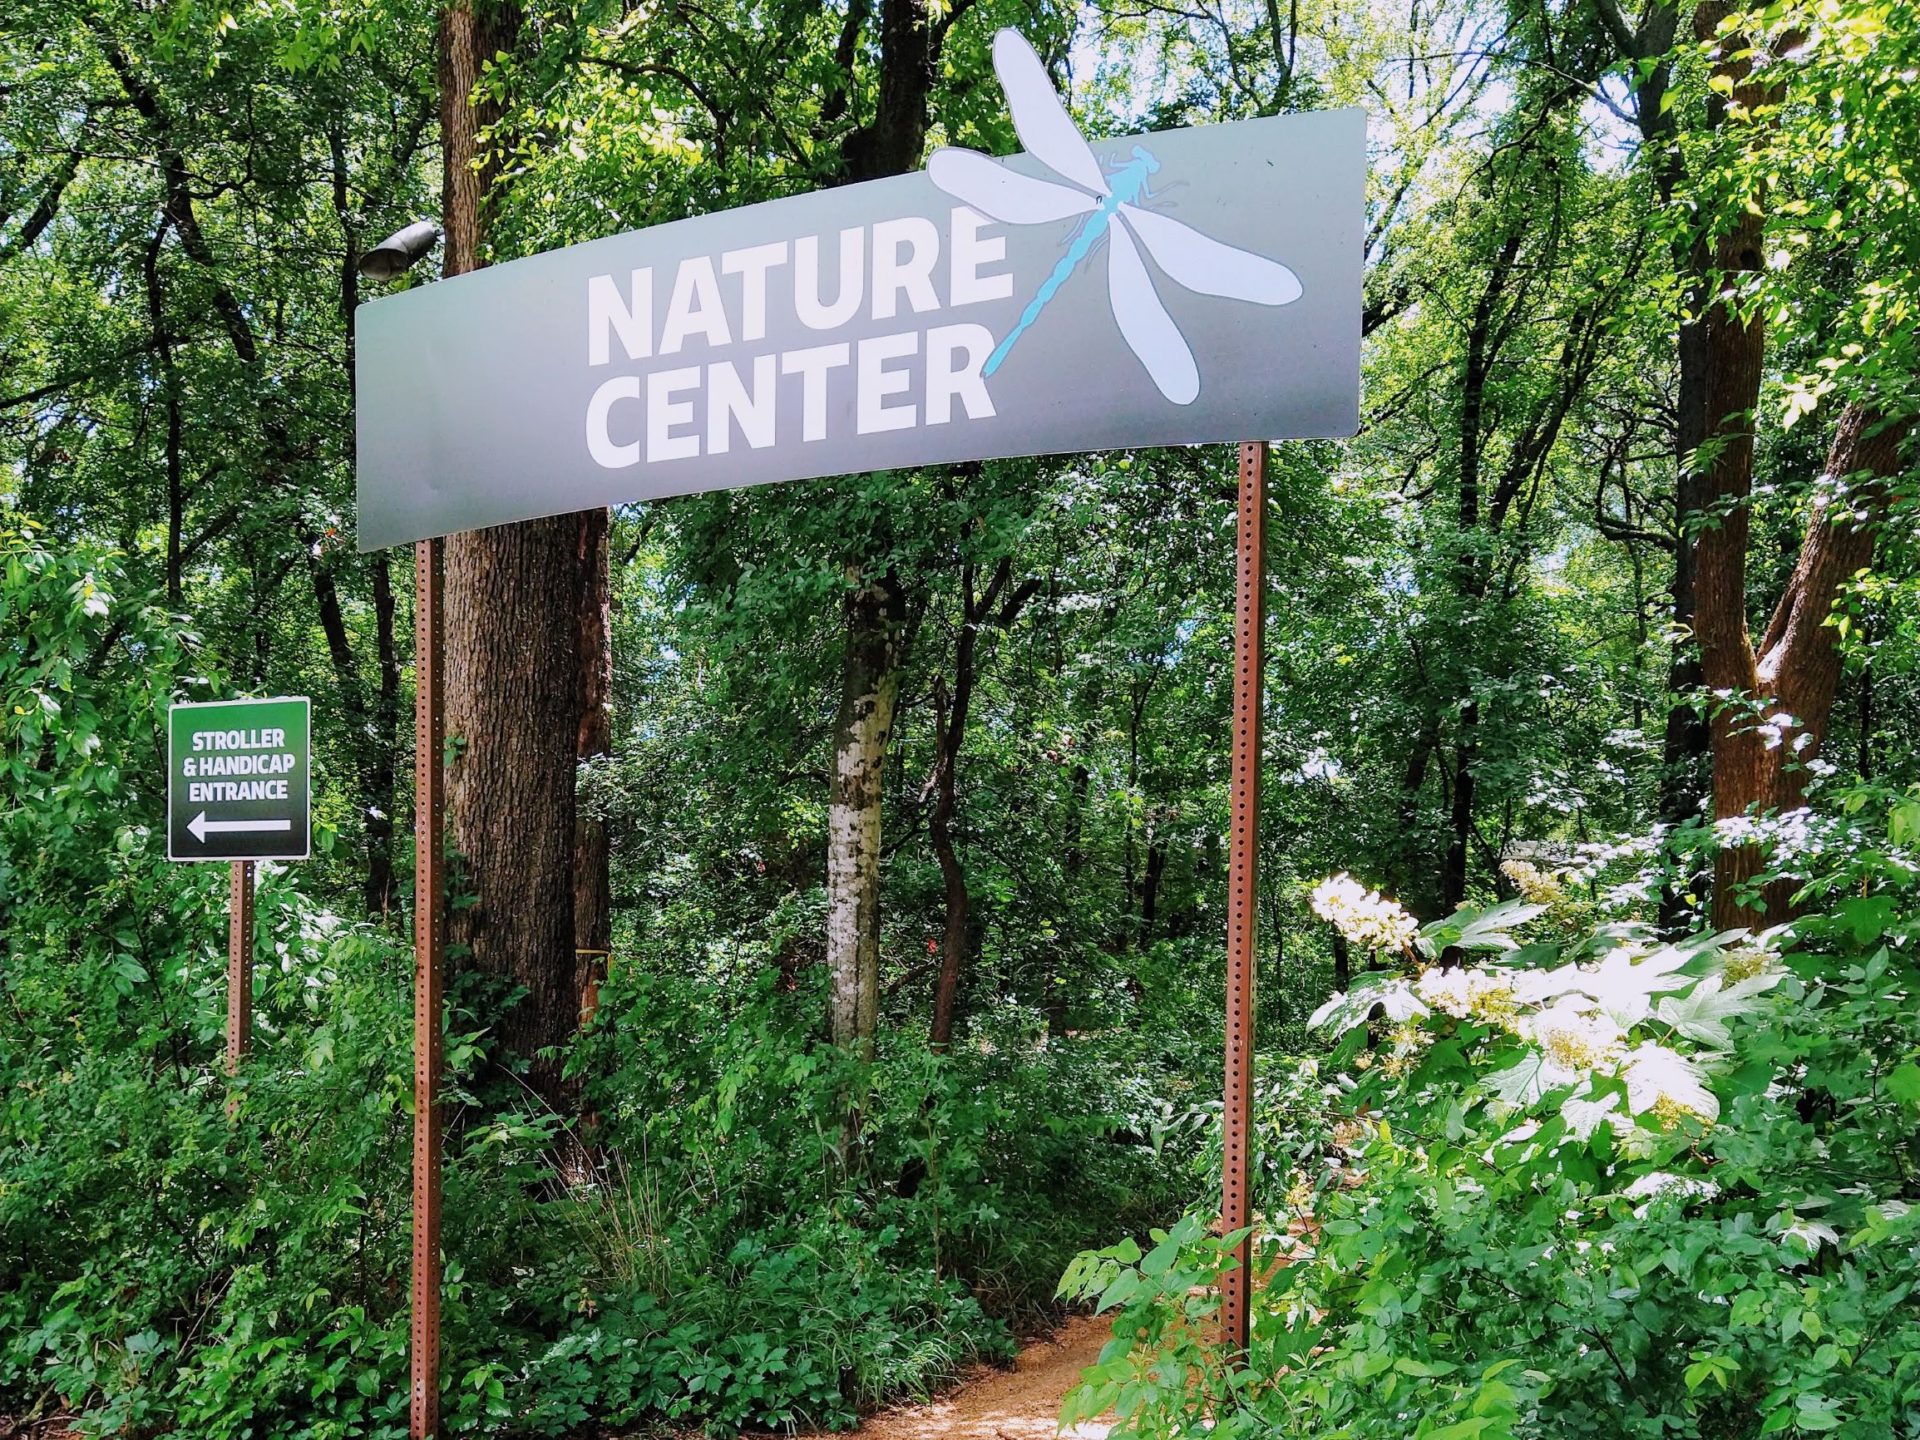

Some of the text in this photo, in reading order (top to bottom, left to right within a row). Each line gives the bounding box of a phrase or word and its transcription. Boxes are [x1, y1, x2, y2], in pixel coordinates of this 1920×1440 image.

[588, 205, 1014, 367] NATURE
[585, 323, 998, 469] CENTER
[192, 728, 285, 751] STROLLER
[183, 754, 296, 777] & HANDICAP
[189, 780, 288, 802] ENTRANCE
